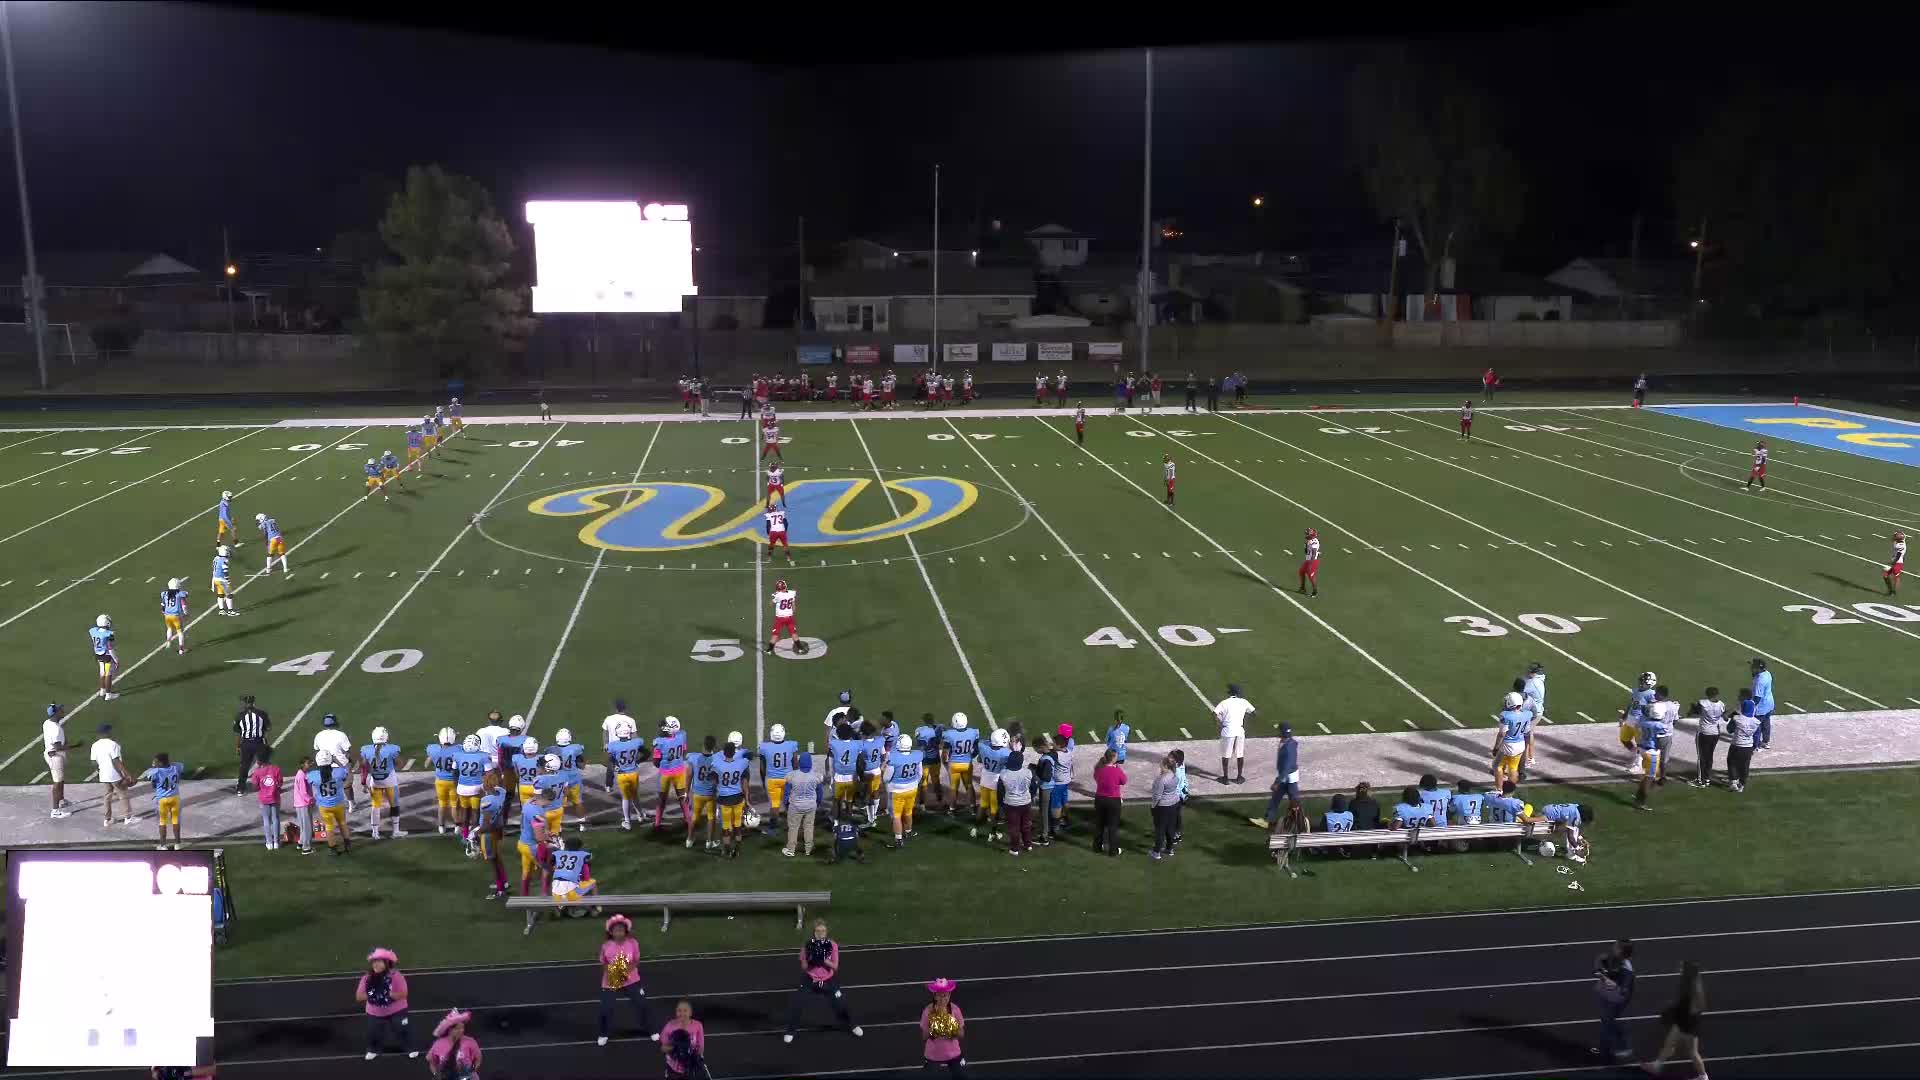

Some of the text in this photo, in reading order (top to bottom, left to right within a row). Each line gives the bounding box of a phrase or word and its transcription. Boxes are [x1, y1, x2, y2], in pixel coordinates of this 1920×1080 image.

[508, 439, 586, 448] 40
[927, 432, 997, 441] 40
[771, 514, 783, 526] 73
[1443, 613, 1582, 637] 30
[1082, 624, 1216, 648] 40
[689, 636, 828, 662] 50
[267, 648, 425, 676] 40
[955, 739, 971, 755] 50
[370, 757, 387, 771] 44
[619, 749, 636, 765] 53
[773, 751, 787, 769] 61
[840, 749, 850, 766] 4
[984, 757, 997, 772] 67
[461, 761, 478, 777] 22
[520, 767, 537, 782] 29
[901, 762, 917, 778] 63
[320, 781, 337, 797] 65
[1429, 799, 1443, 815] 71
[1469, 800, 1477, 814] 7
[557, 855, 578, 870] 33
